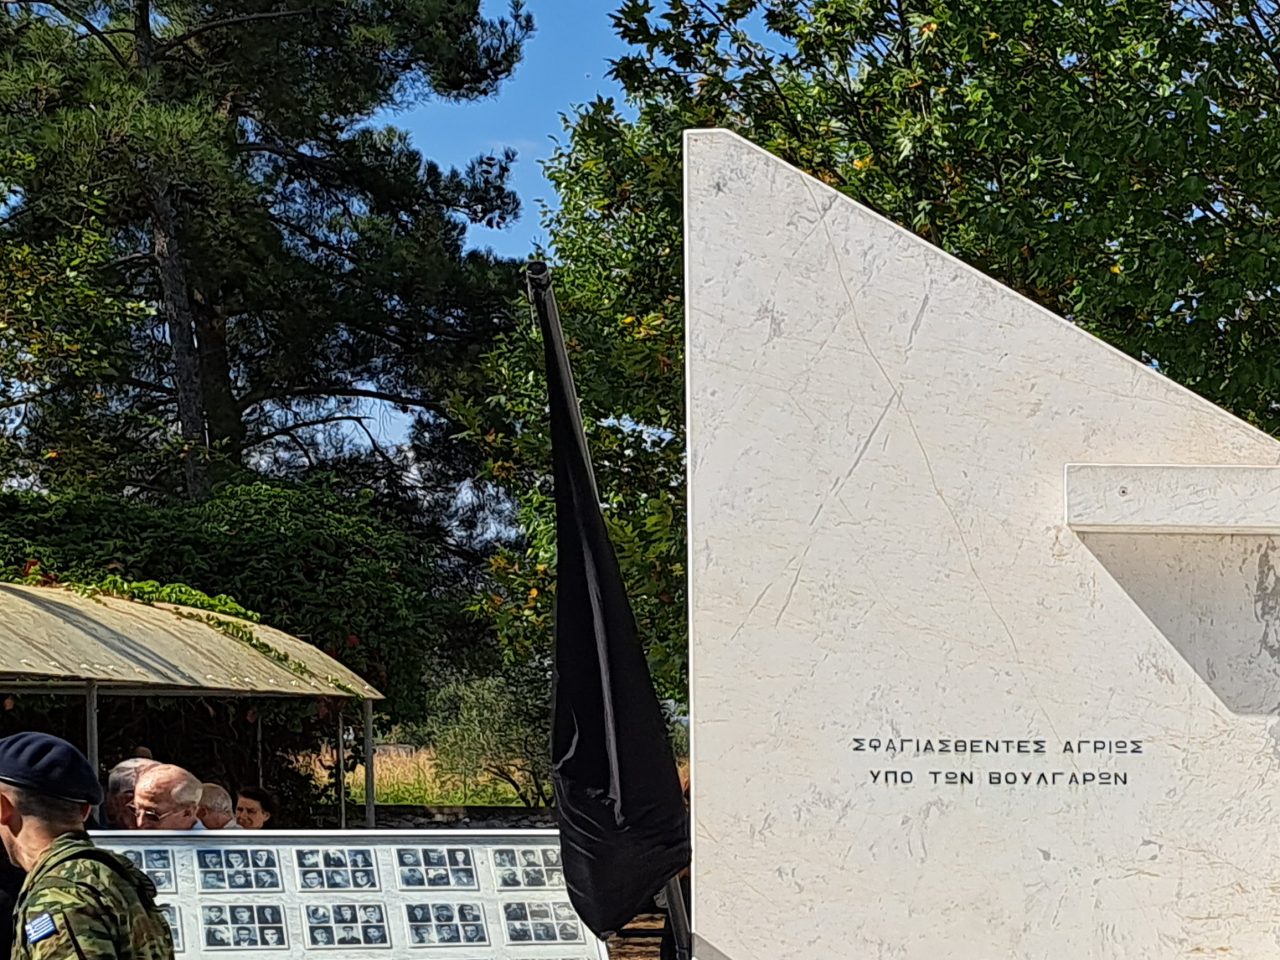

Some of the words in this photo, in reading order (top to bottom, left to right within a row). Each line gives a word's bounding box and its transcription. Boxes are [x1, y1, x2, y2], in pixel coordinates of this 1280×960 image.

[852, 738, 1046, 754] ΣΦΑΓΙΑΣΘΕΝΤΕΣ
[1062, 740, 1143, 754] ΑΓΡΙΩΣ
[870, 770, 913, 784] ΥΠΟ
[929, 771, 974, 785] ΤΩΝ
[988, 771, 1127, 785] ΒΟΥΛΓΑΡΩΝ
